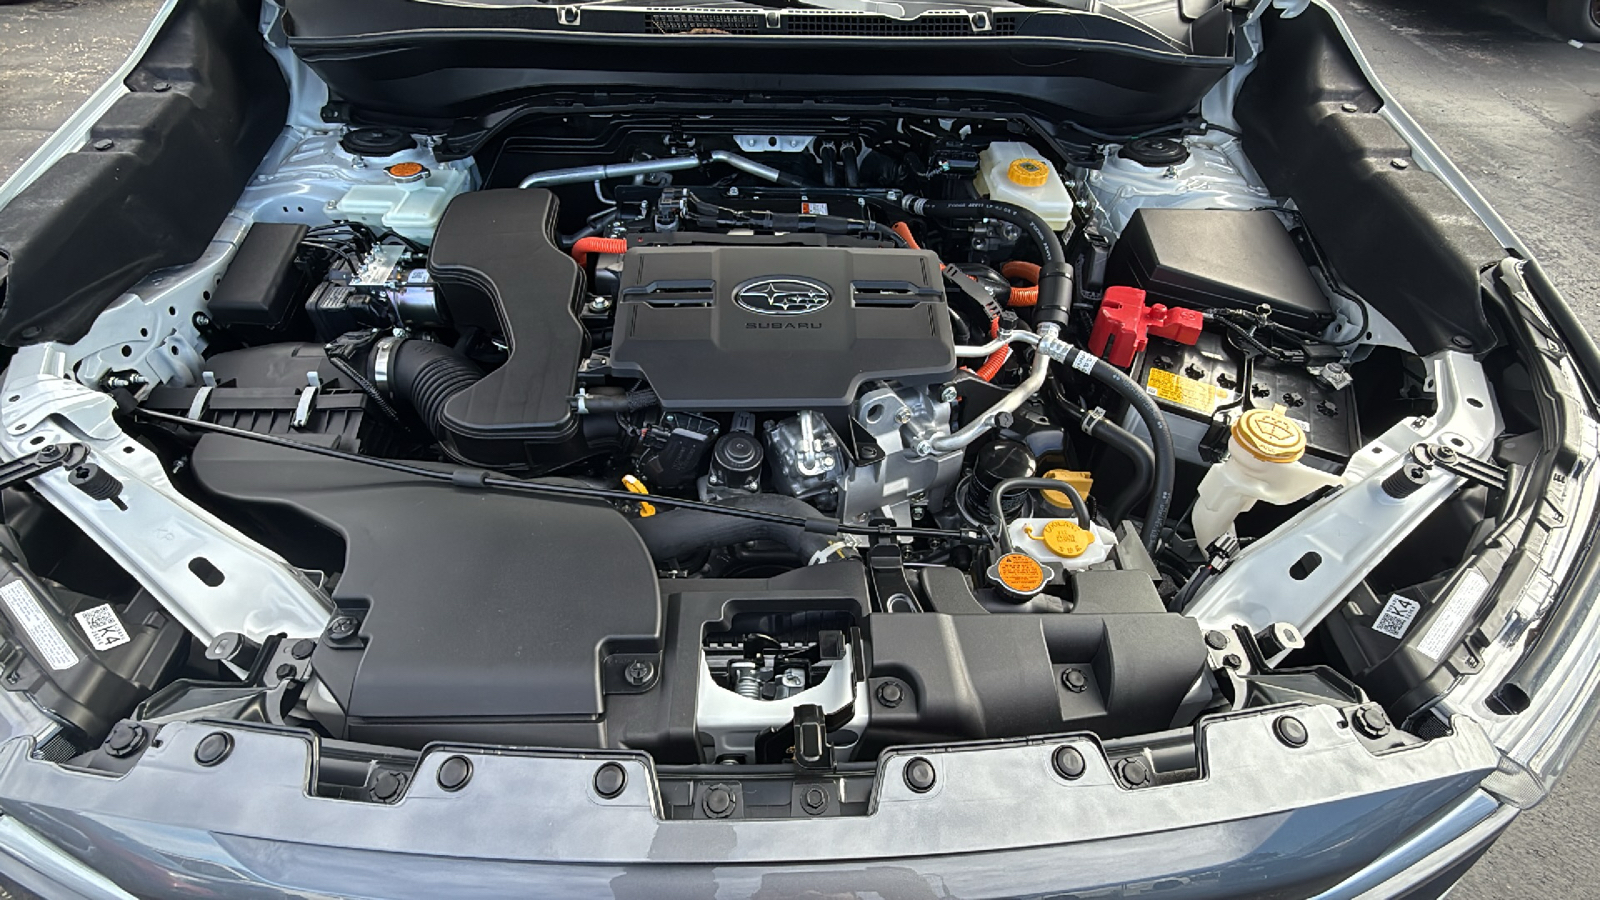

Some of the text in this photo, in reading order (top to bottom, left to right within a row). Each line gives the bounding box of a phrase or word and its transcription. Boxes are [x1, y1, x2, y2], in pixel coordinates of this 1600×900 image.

[745, 322, 822, 330] SUBARU
[1391, 599, 1413, 618] K4
[97, 623, 121, 646] K4
